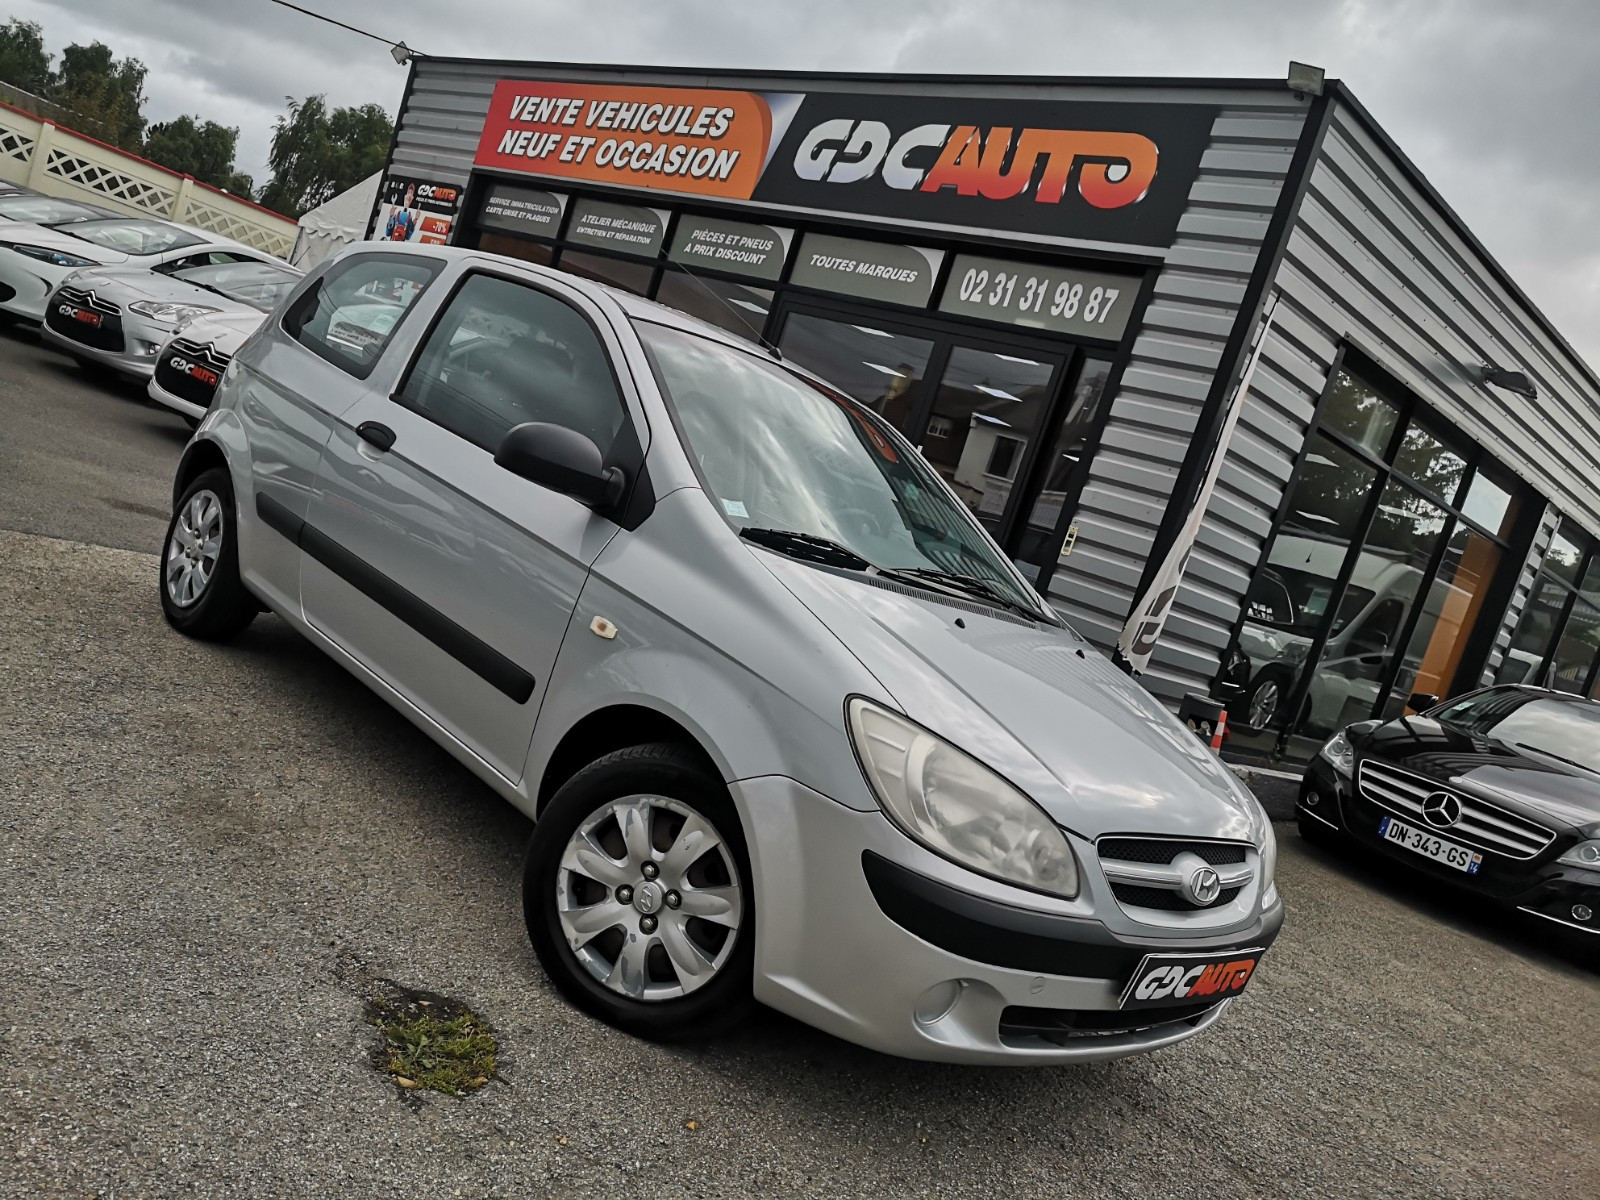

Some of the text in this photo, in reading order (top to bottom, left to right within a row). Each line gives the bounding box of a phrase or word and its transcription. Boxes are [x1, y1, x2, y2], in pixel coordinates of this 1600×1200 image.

[509, 95, 735, 138] VENTE VEHICULES
[498, 129, 740, 180] NEUF ET OCCASION
[485, 206, 551, 223] CARTE GRISE ET PLAQUES
[488, 196, 560, 214] SERVICE IMMATRICULATION
[576, 226, 652, 244] ENTRETIEN ET RÉPARATION
[581, 214, 657, 233] ATELIER MÉCANIQUE
[691, 228, 774, 251] PIÈCES ET PNEUS
[683, 242, 767, 265] A PRIX DISCOUNT
[809, 253, 918, 283] TOUTES MARQUES
[959, 267, 1120, 324] 02 31 31 98 87
